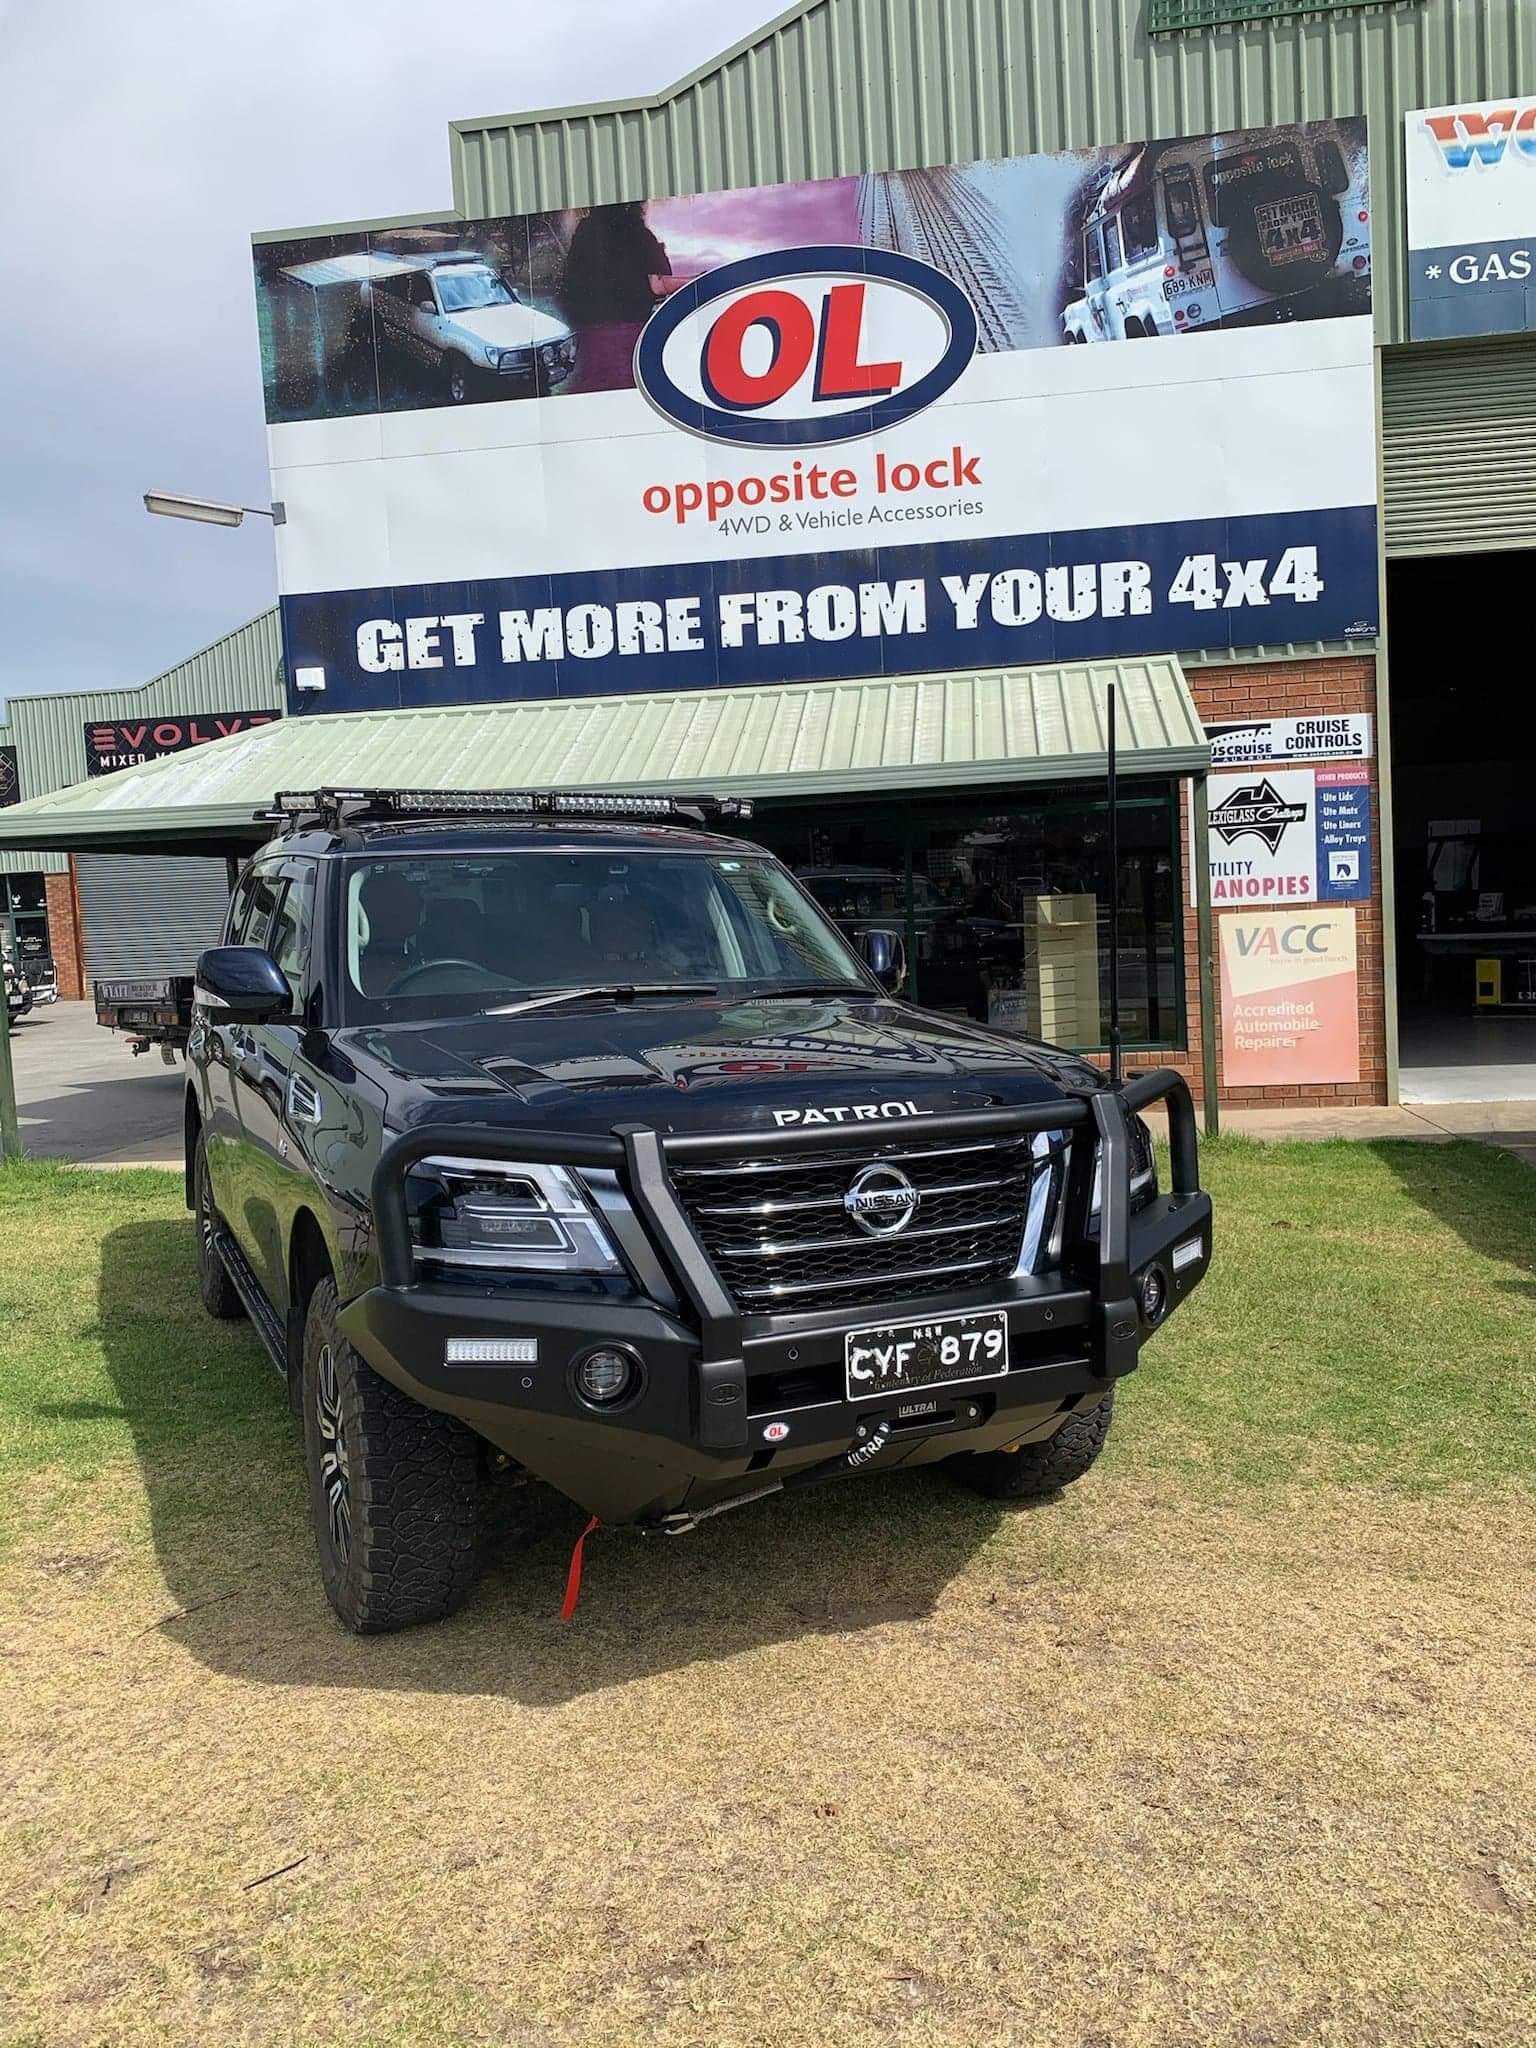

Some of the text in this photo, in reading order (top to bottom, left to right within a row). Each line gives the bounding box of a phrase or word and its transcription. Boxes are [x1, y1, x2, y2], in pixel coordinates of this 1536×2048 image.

[1449, 250, 1532, 284] GAS
[700, 283, 903, 411] OL
[642, 446, 982, 524] opposite lock
[718, 500, 984, 537] 4WD & Vehicle Accessories
[356, 546, 1325, 674] GET MORE FROM YOUR 4x4
[92, 717, 273, 751] EVOLV
[1296, 720, 1350, 734] CRUISE
[1285, 733, 1362, 750] CONTROLS
[100, 754, 146, 768] MIXED
[1317, 772, 1368, 781] OTHER PRODUCTS
[1338, 792, 1354, 801] Lids
[1208, 809, 1256, 825] LEXIGLASS
[1339, 806, 1358, 815] Mats
[1339, 820, 1361, 829] Liners
[1345, 834, 1366, 844] Trays
[1209, 861, 1253, 877] TILITY
[1214, 876, 1310, 898] ANOPIES
[1235, 924, 1332, 956] VACC
[1233, 1001, 1314, 1017] Accredited
[1233, 1018, 1321, 1033] Automobile
[1234, 1035, 1297, 1051] Repairer
[772, 1101, 934, 1126] PATROL
[855, 1192, 915, 1210] NISSAN
[851, 1329, 1003, 1380] CYF 879
[901, 1402, 935, 1414] ULTRA
[768, 1426, 784, 1437] OL
[848, 1434, 885, 1467] ULTRA
